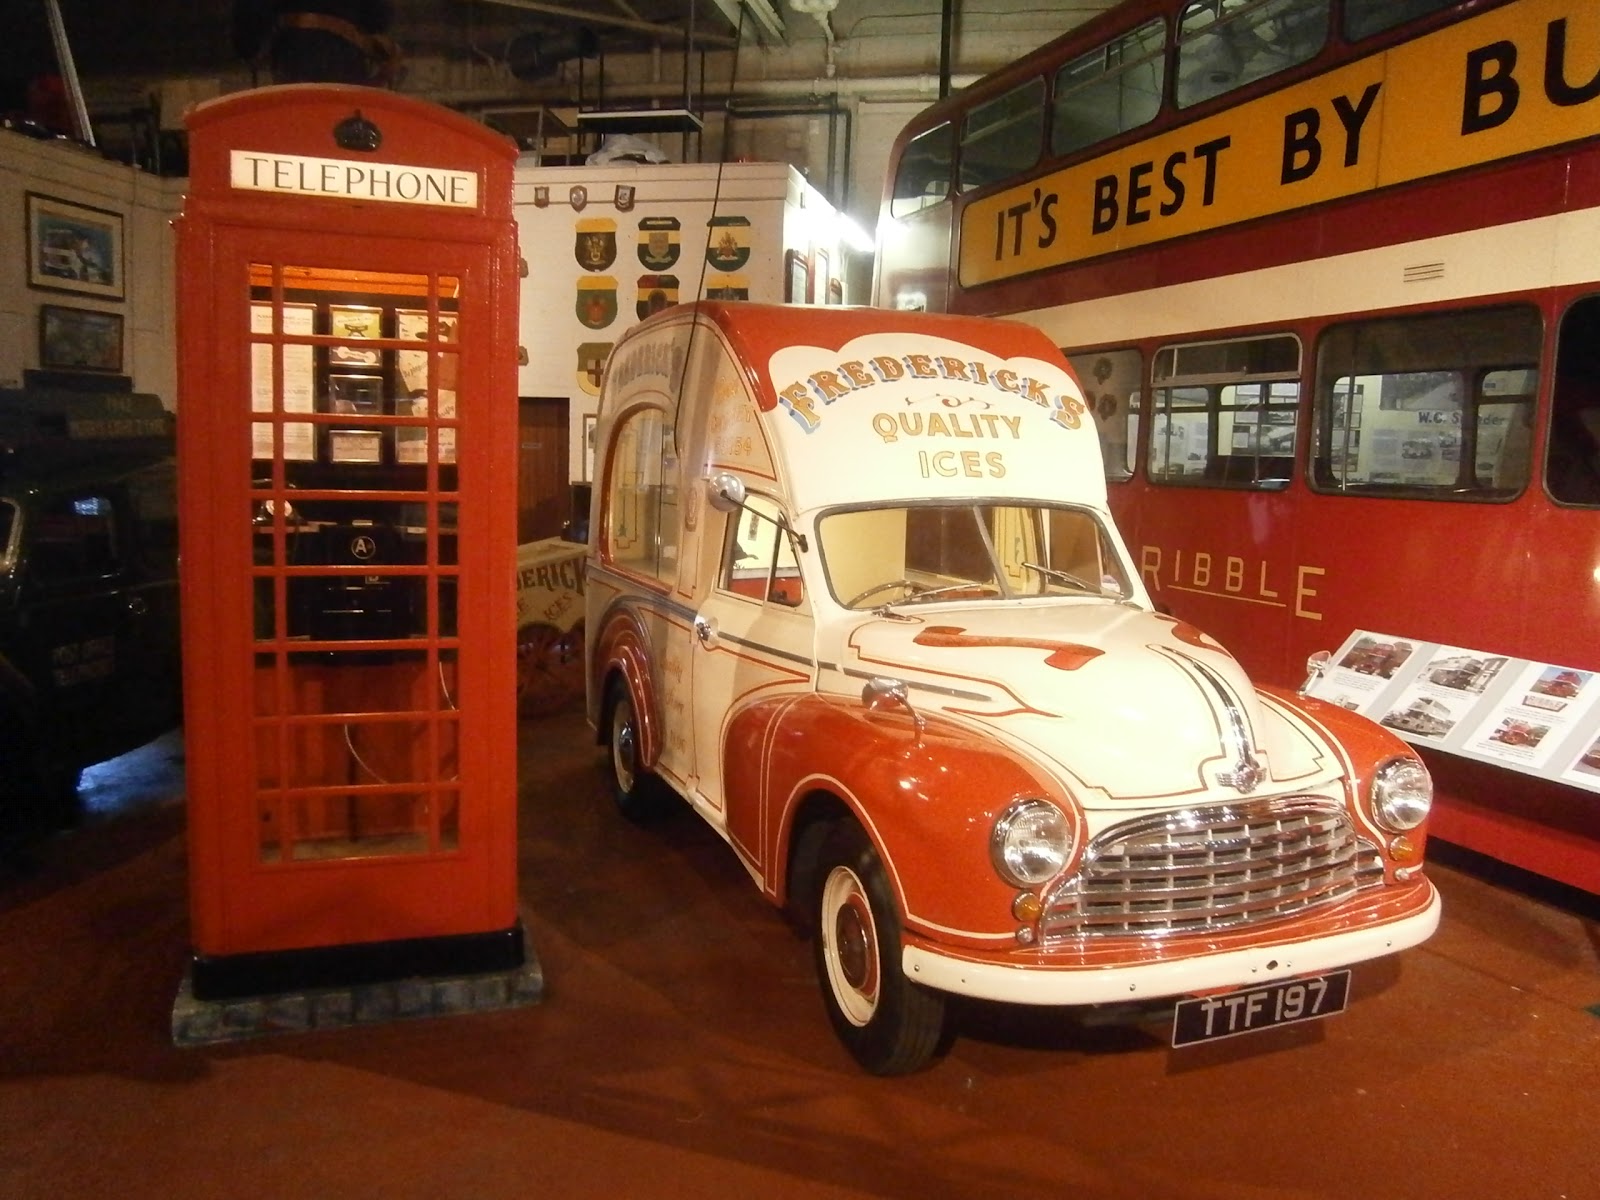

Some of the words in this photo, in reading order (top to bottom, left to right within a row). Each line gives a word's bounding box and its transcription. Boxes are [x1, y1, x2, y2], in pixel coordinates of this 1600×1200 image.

[995, 187, 1059, 262] IT'S
[1092, 135, 1232, 236] BEST
[1280, 81, 1383, 186] BY
[1461, 17, 1600, 136] BU
[244, 157, 468, 204] TELEPHONE
[778, 354, 1086, 434] FREDERICKS
[872, 412, 1021, 443] QUALITY
[918, 450, 1007, 479] ICES
[355, 538, 367, 554] A
[1142, 545, 1326, 621] RIBBLE
[1201, 992, 1268, 1036] TTF
[1274, 980, 1328, 1022] 197
